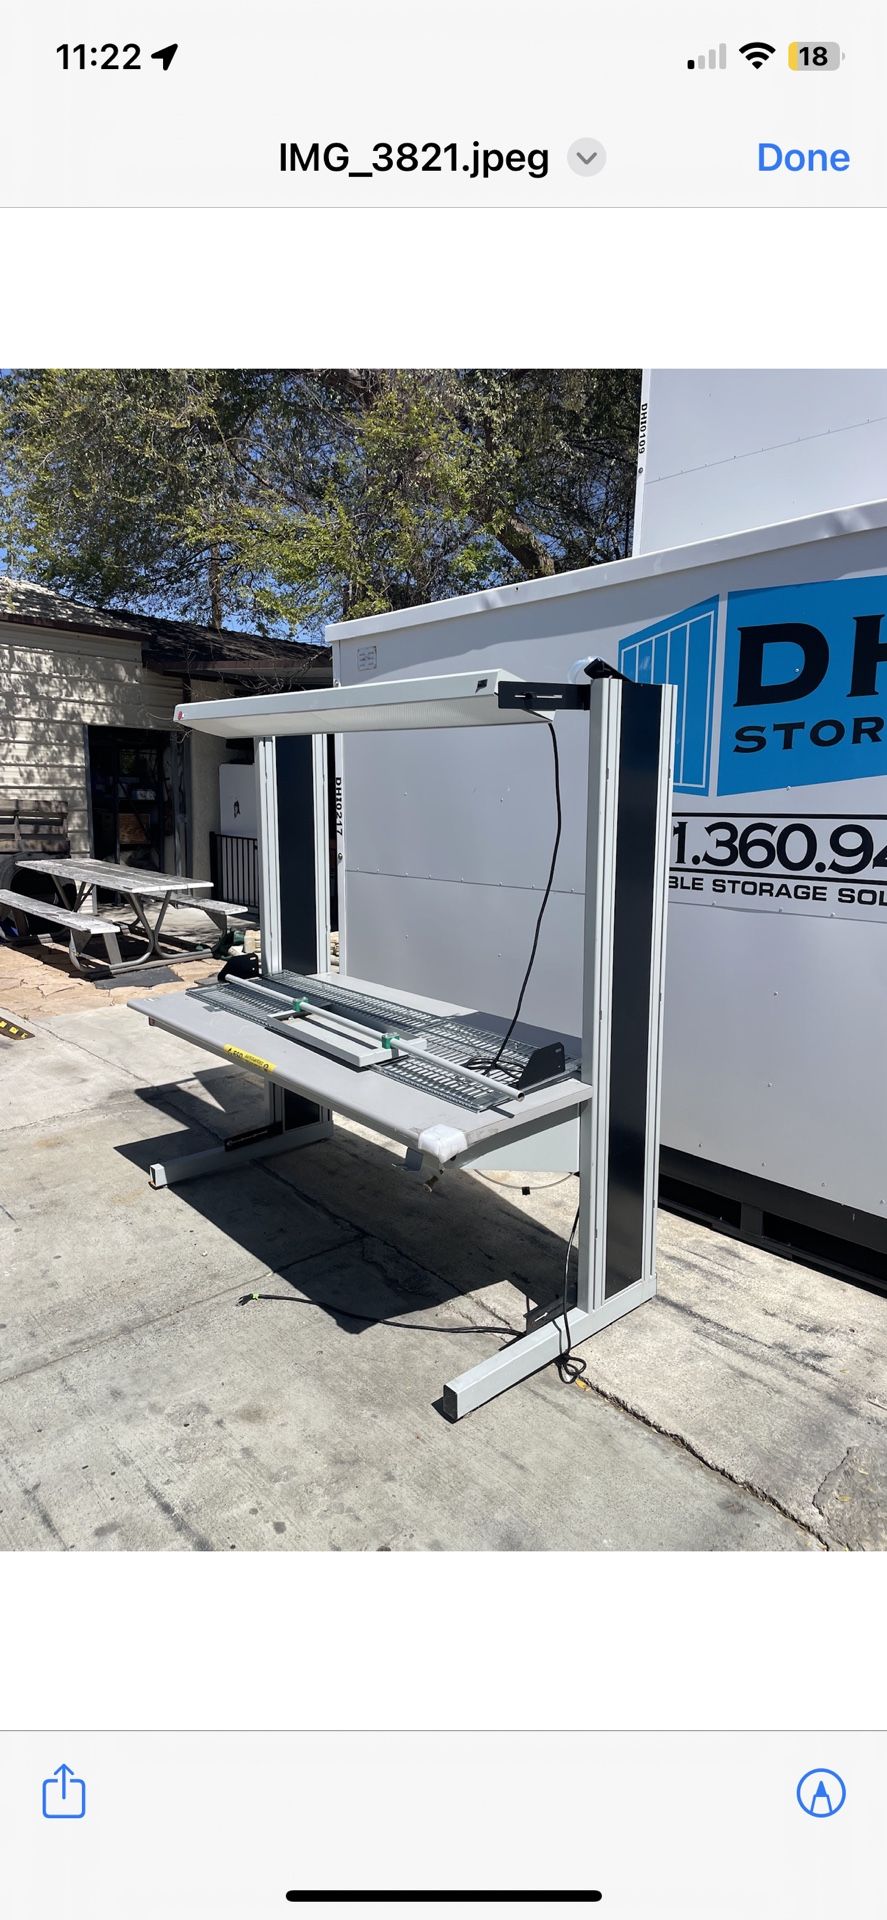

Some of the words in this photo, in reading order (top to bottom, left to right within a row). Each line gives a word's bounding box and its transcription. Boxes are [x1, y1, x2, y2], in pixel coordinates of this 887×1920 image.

[732, 716, 885, 753] STOR
[712, 878, 828, 902] STORAGE
[837, 887, 887, 907] SOL
